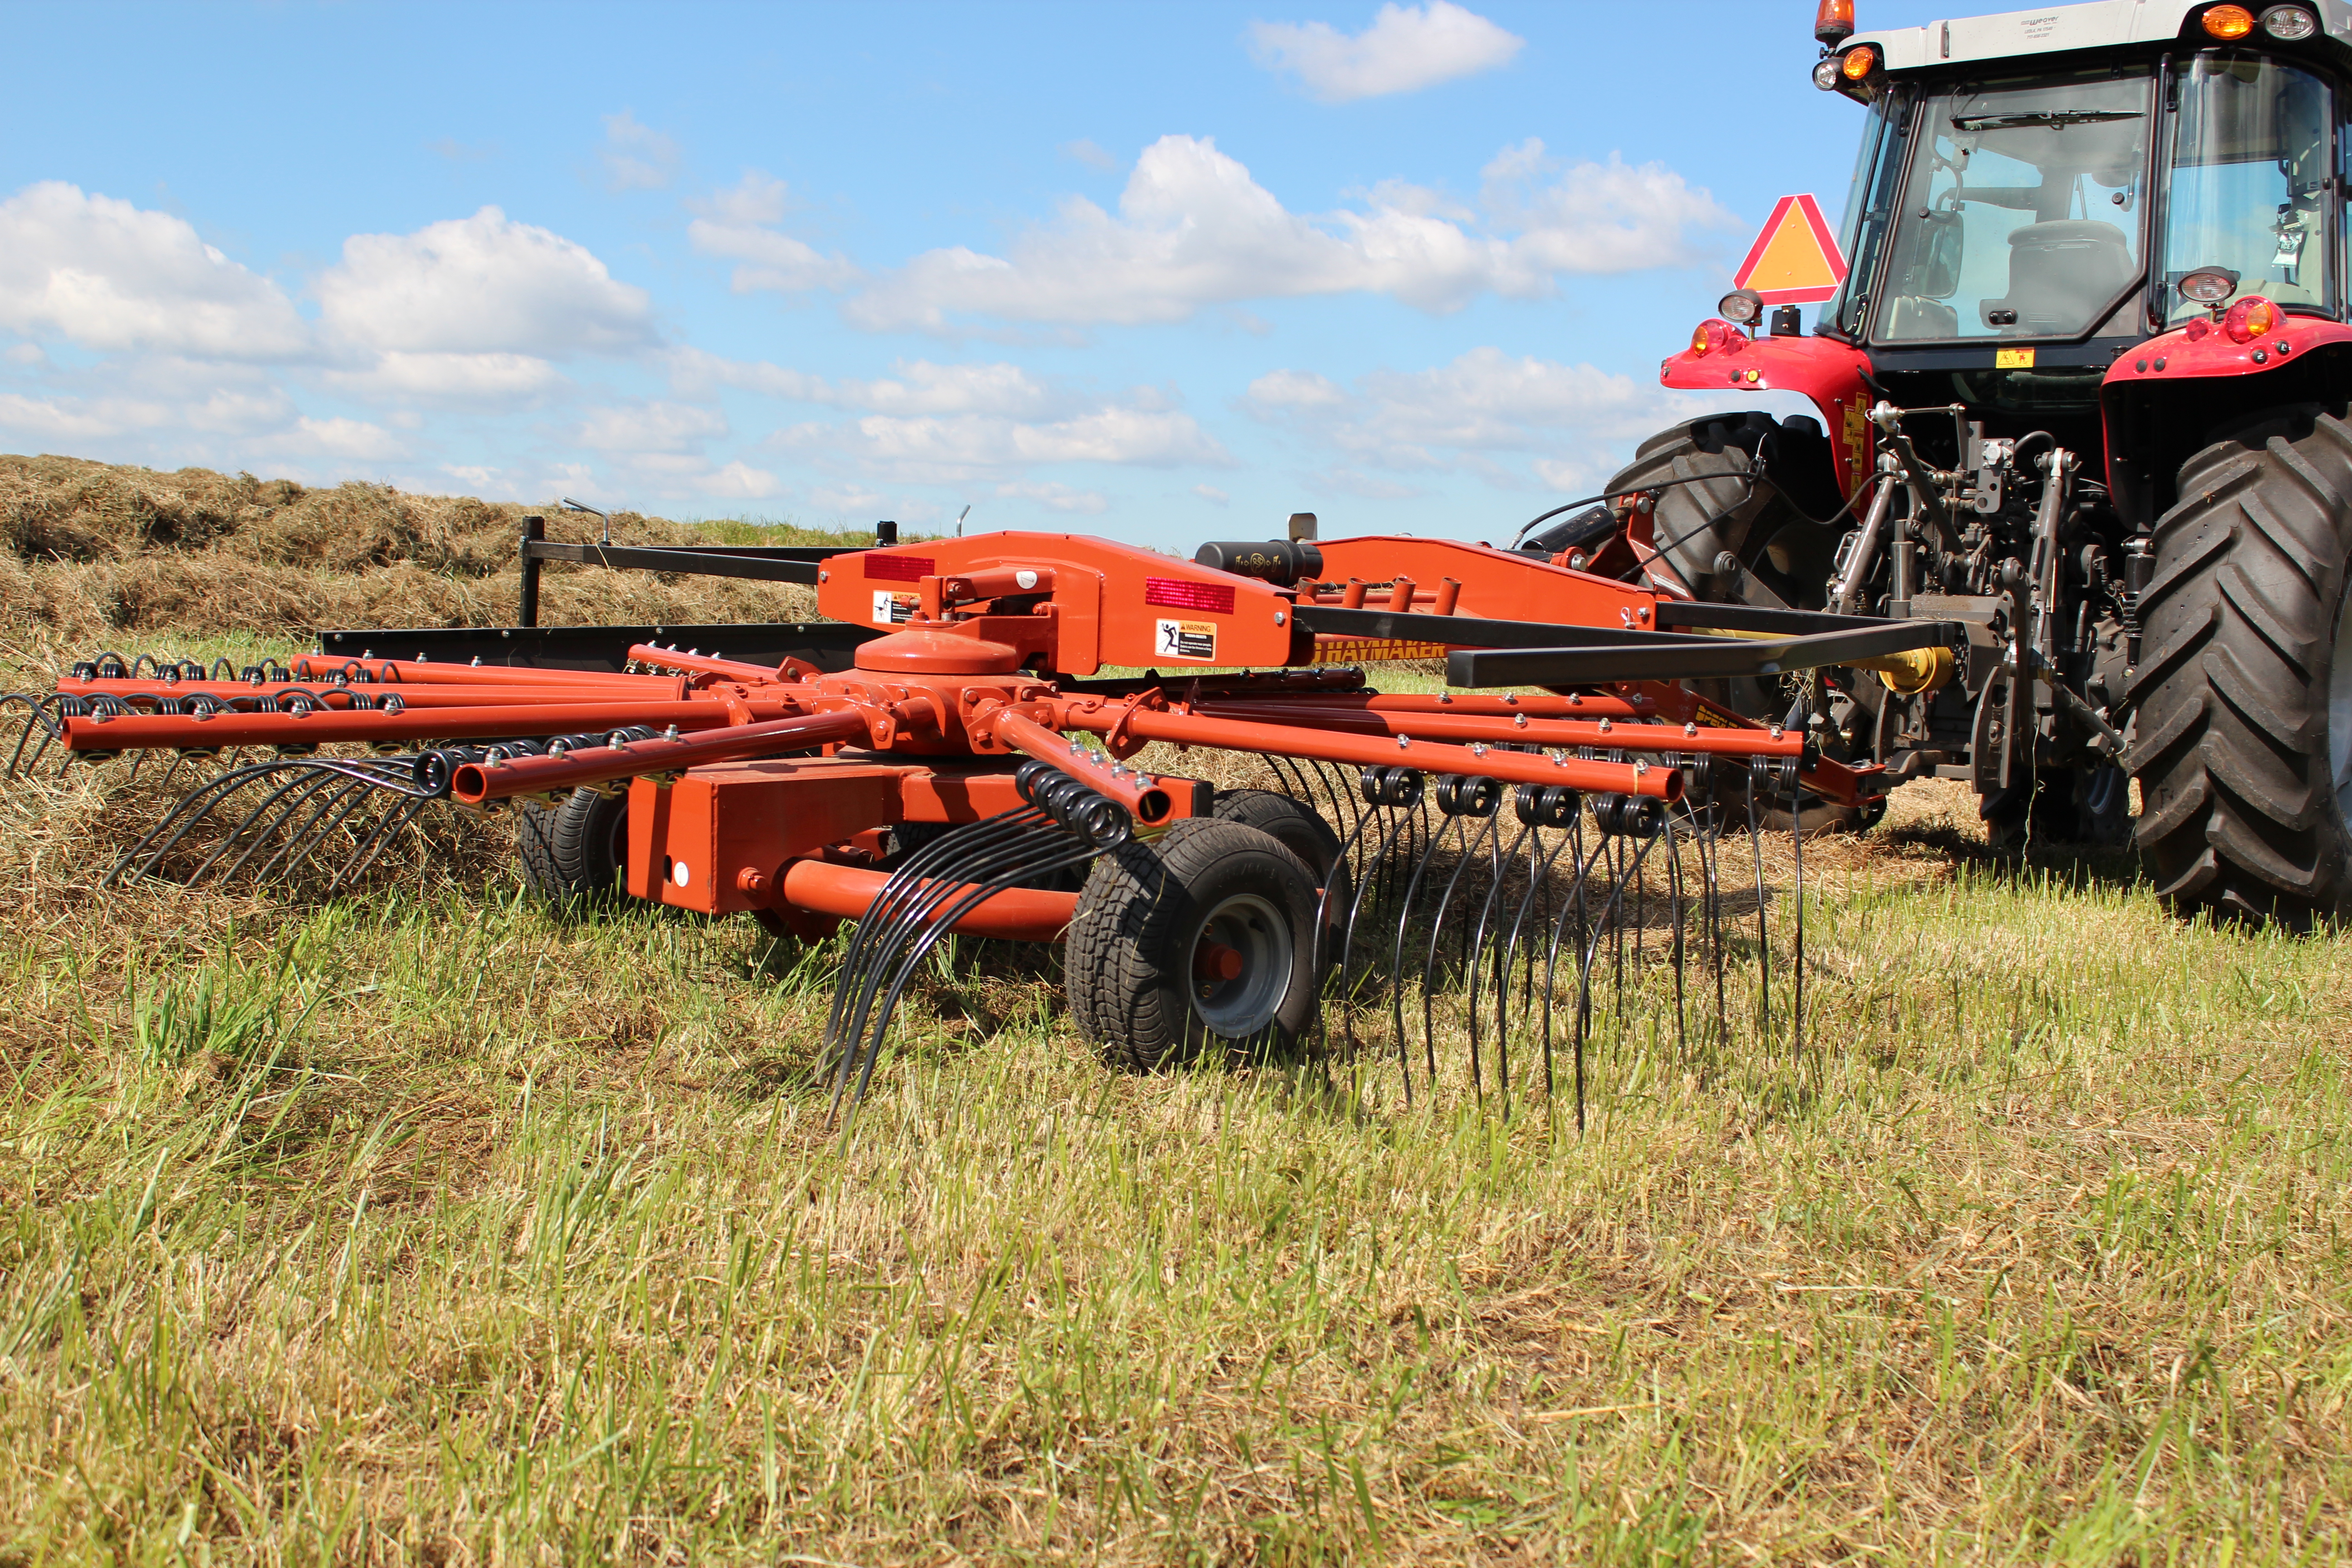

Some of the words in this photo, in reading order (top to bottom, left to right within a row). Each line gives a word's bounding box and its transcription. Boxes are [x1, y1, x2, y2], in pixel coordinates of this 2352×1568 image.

[2029, 16, 2059, 25] Weaver
[1186, 624, 1211, 632] WARNING
[1326, 640, 1446, 662] HAYMAKER
